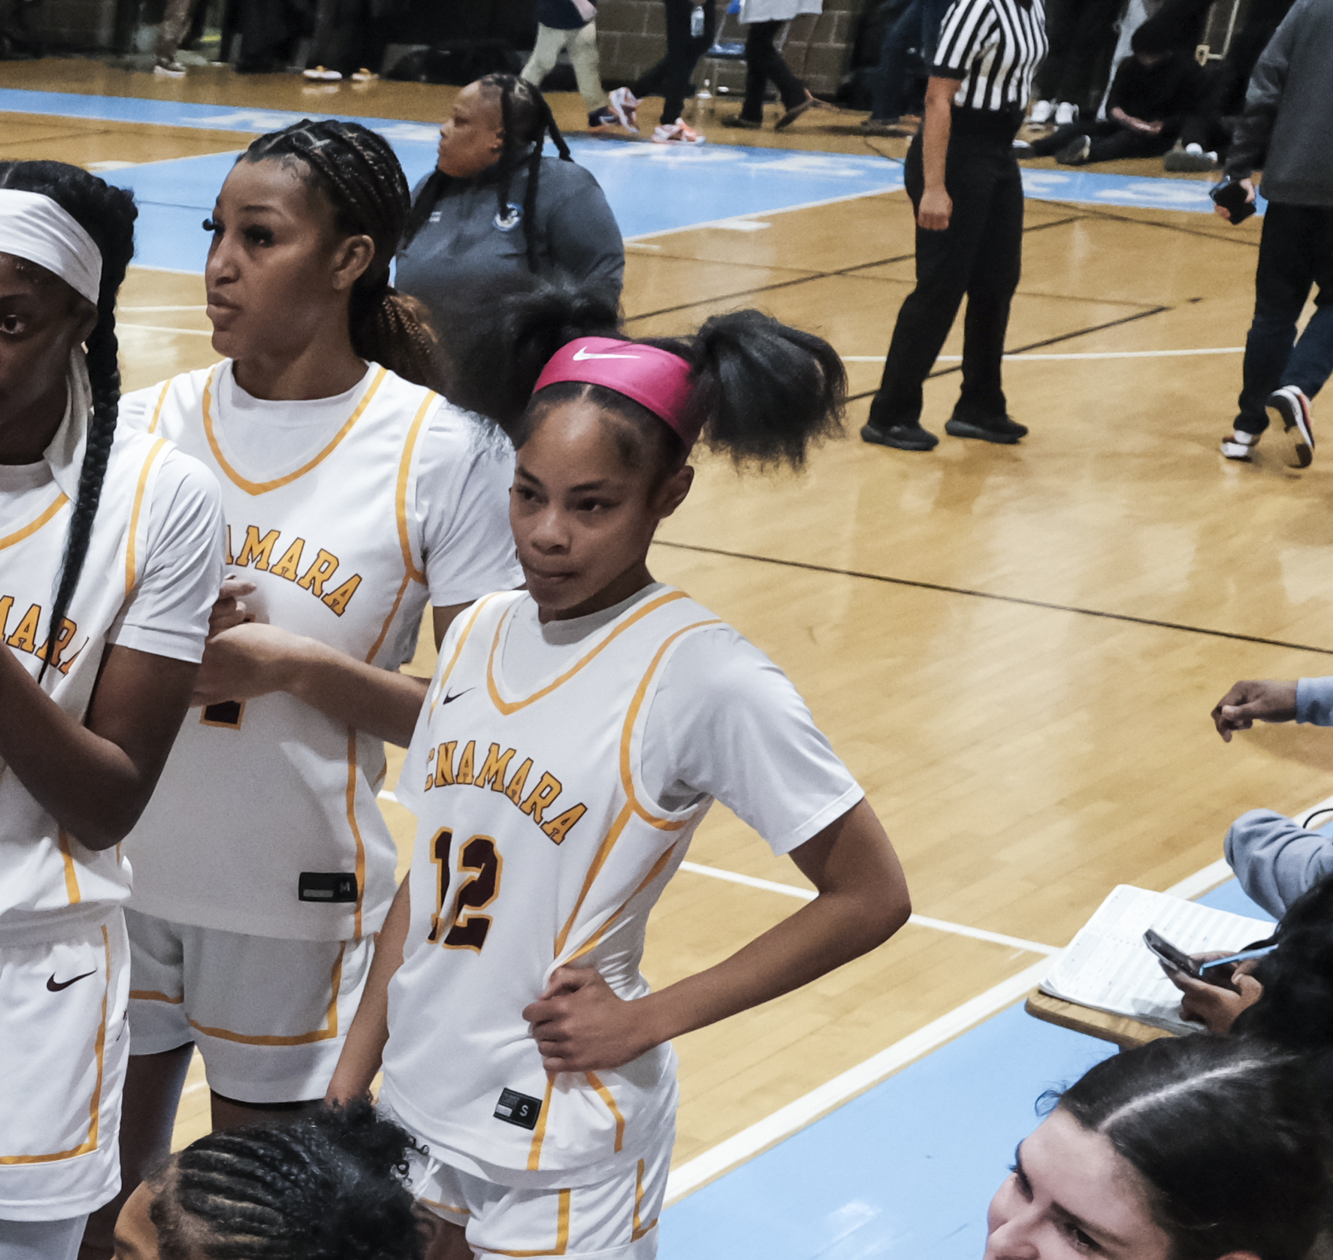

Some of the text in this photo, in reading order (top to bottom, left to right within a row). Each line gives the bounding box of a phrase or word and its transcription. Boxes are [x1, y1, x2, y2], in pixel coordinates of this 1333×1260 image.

[226, 524, 363, 618] MARA
[424, 740, 588, 846] NAMARA
[426, 826, 504, 957] 12
[519, 1104, 529, 1117] S
